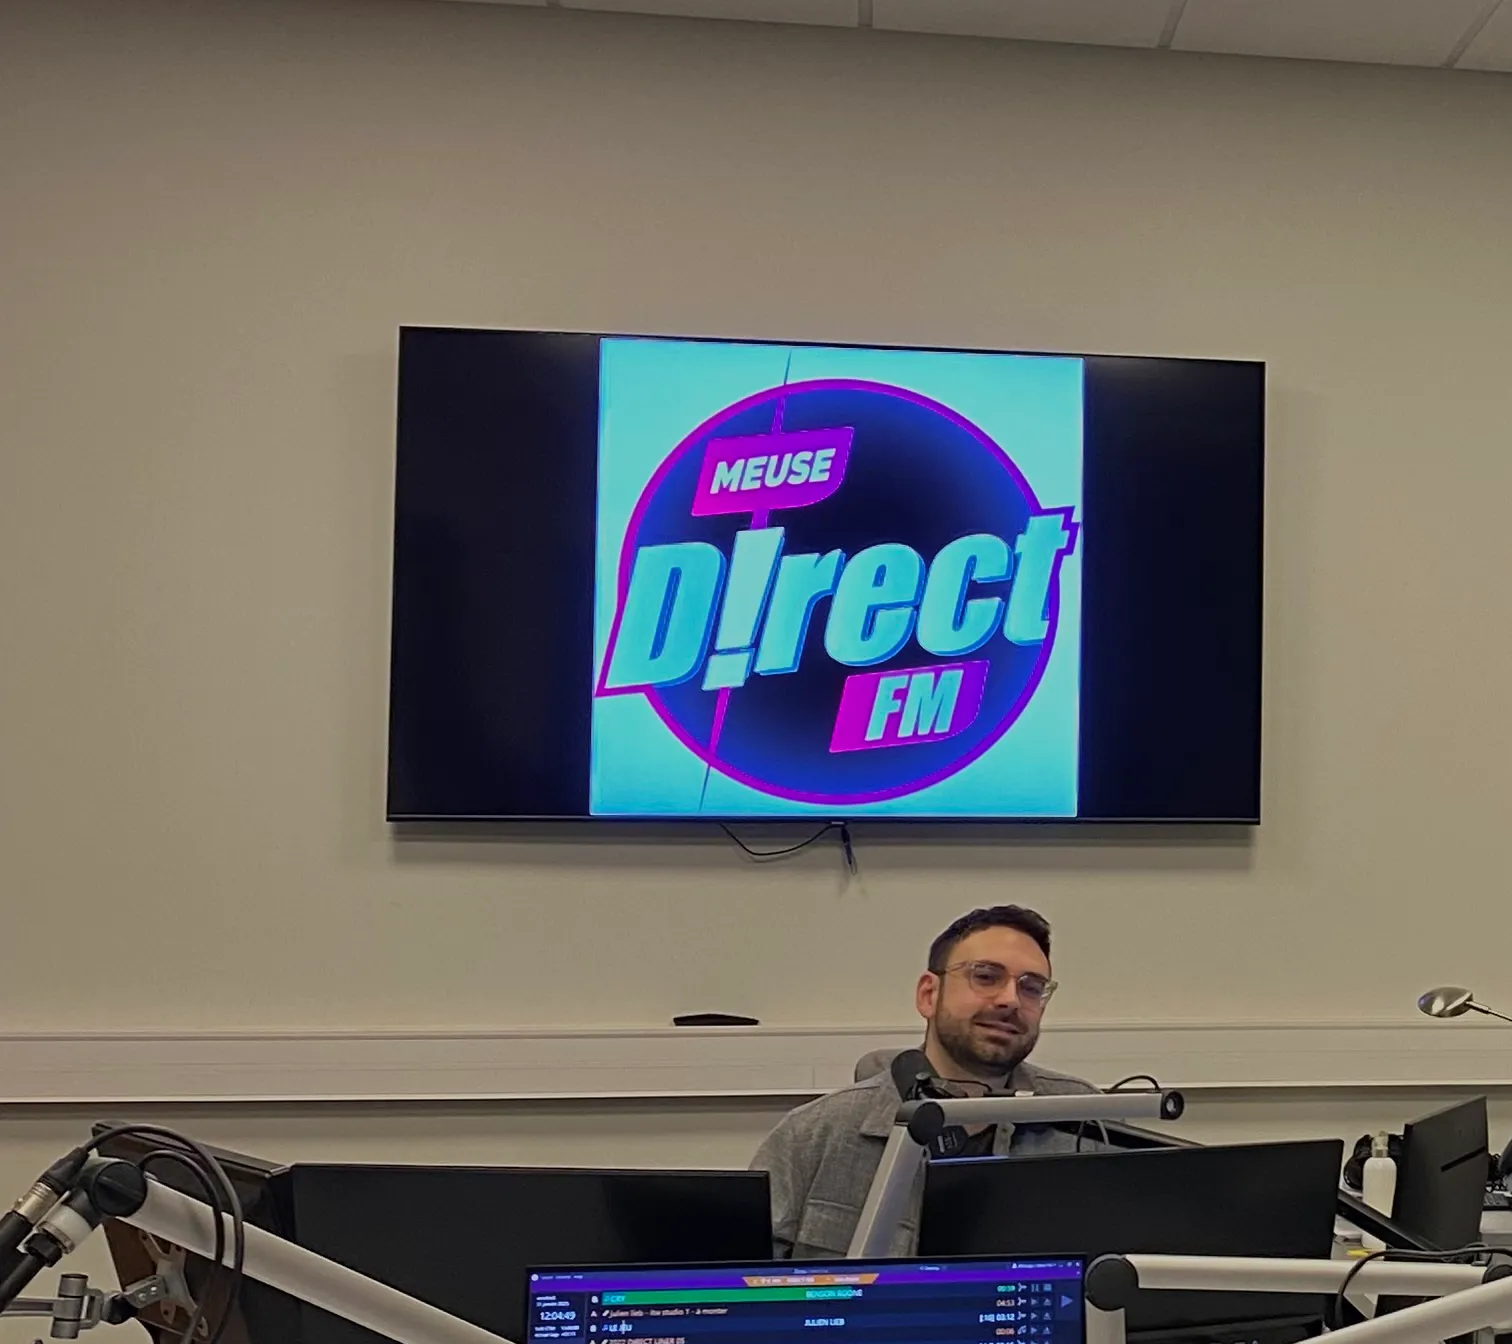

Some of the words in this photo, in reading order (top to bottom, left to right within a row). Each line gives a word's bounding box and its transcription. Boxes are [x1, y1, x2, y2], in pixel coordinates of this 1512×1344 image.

[709, 448, 837, 495] MEUSE
[864, 670, 964, 742] FM
[540, 1310, 576, 1321] 12:04:49
